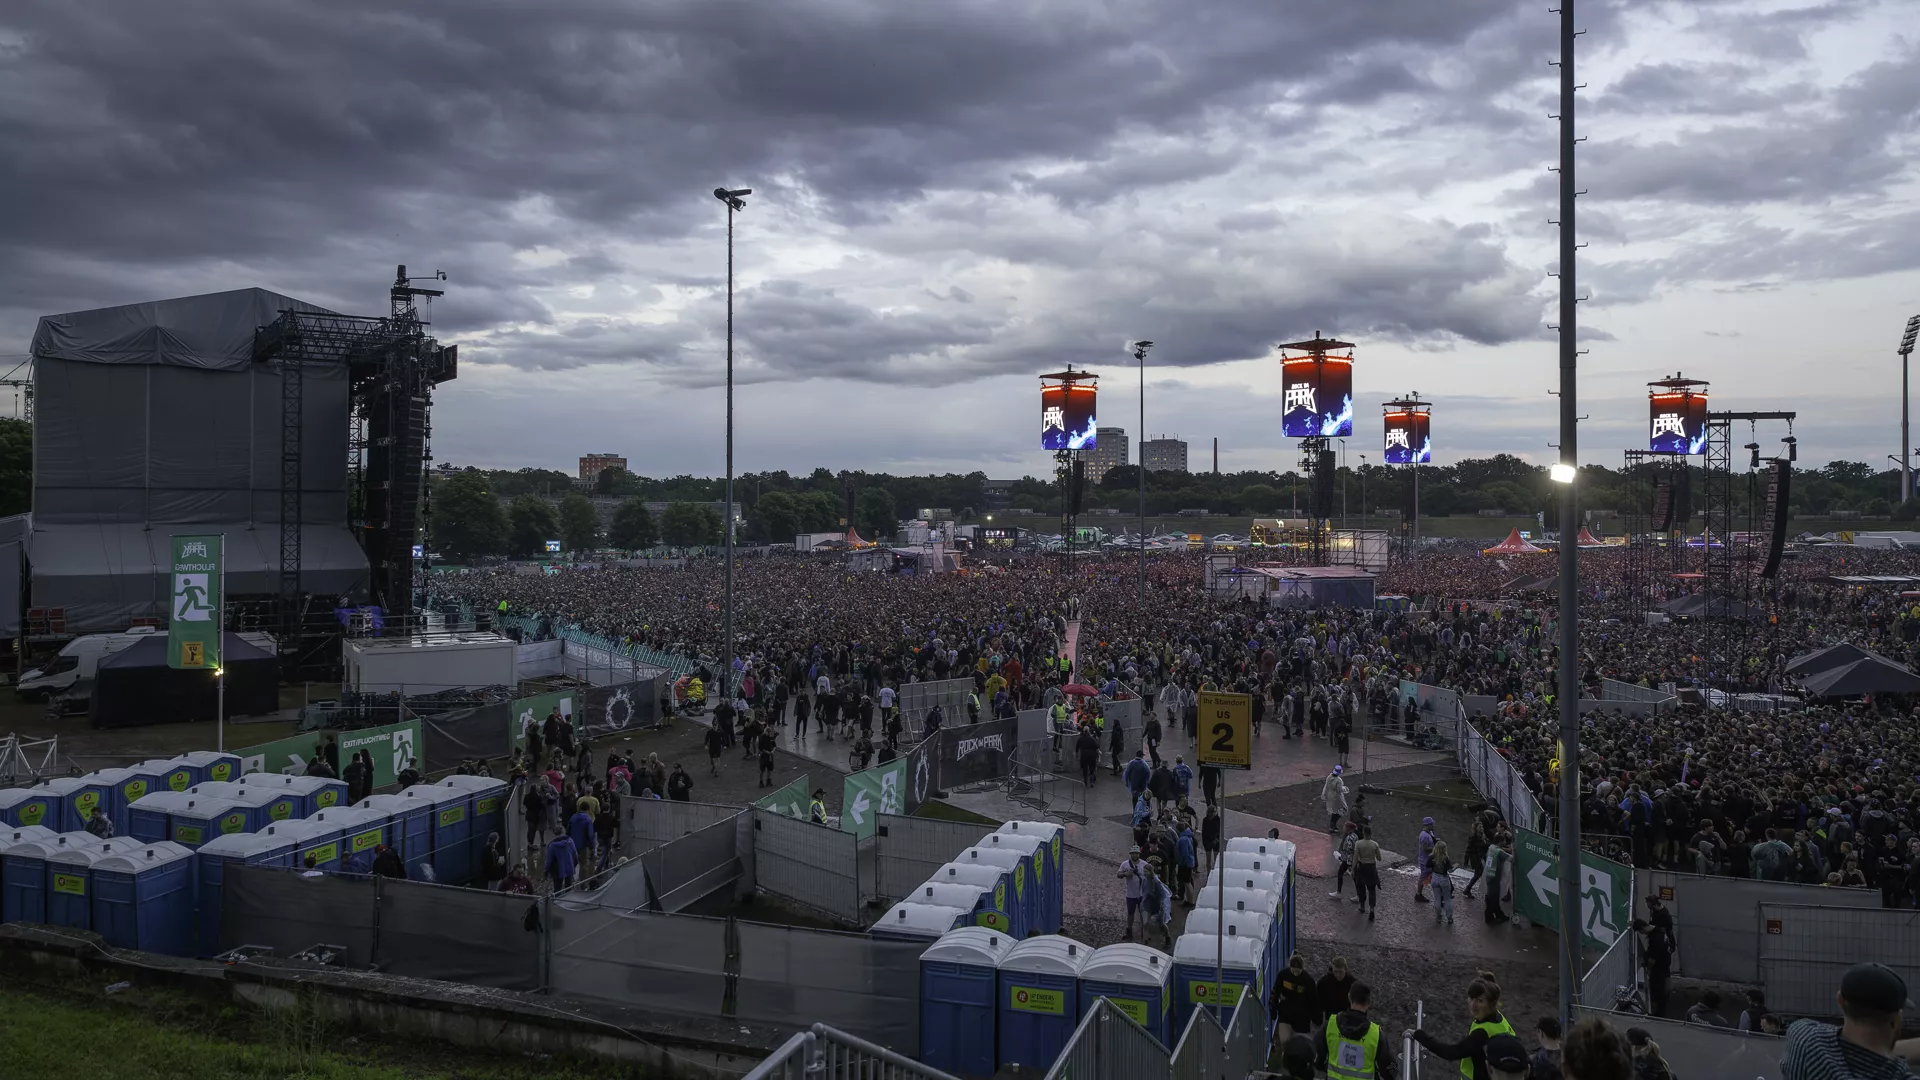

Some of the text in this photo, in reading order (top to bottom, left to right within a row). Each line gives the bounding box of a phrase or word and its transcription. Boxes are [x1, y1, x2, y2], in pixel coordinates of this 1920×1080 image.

[1284, 387, 1318, 416] PARK
[1043, 410, 1066, 433] PARK
[1652, 417, 1686, 439] PARK
[1385, 431, 1410, 450] PARK
[1203, 697, 1246, 707] Ihr Standort
[1216, 710, 1231, 719] US
[957, 738, 979, 761] ROCK
[983, 733, 1004, 752] PARK
[1211, 722, 1234, 752] 2
